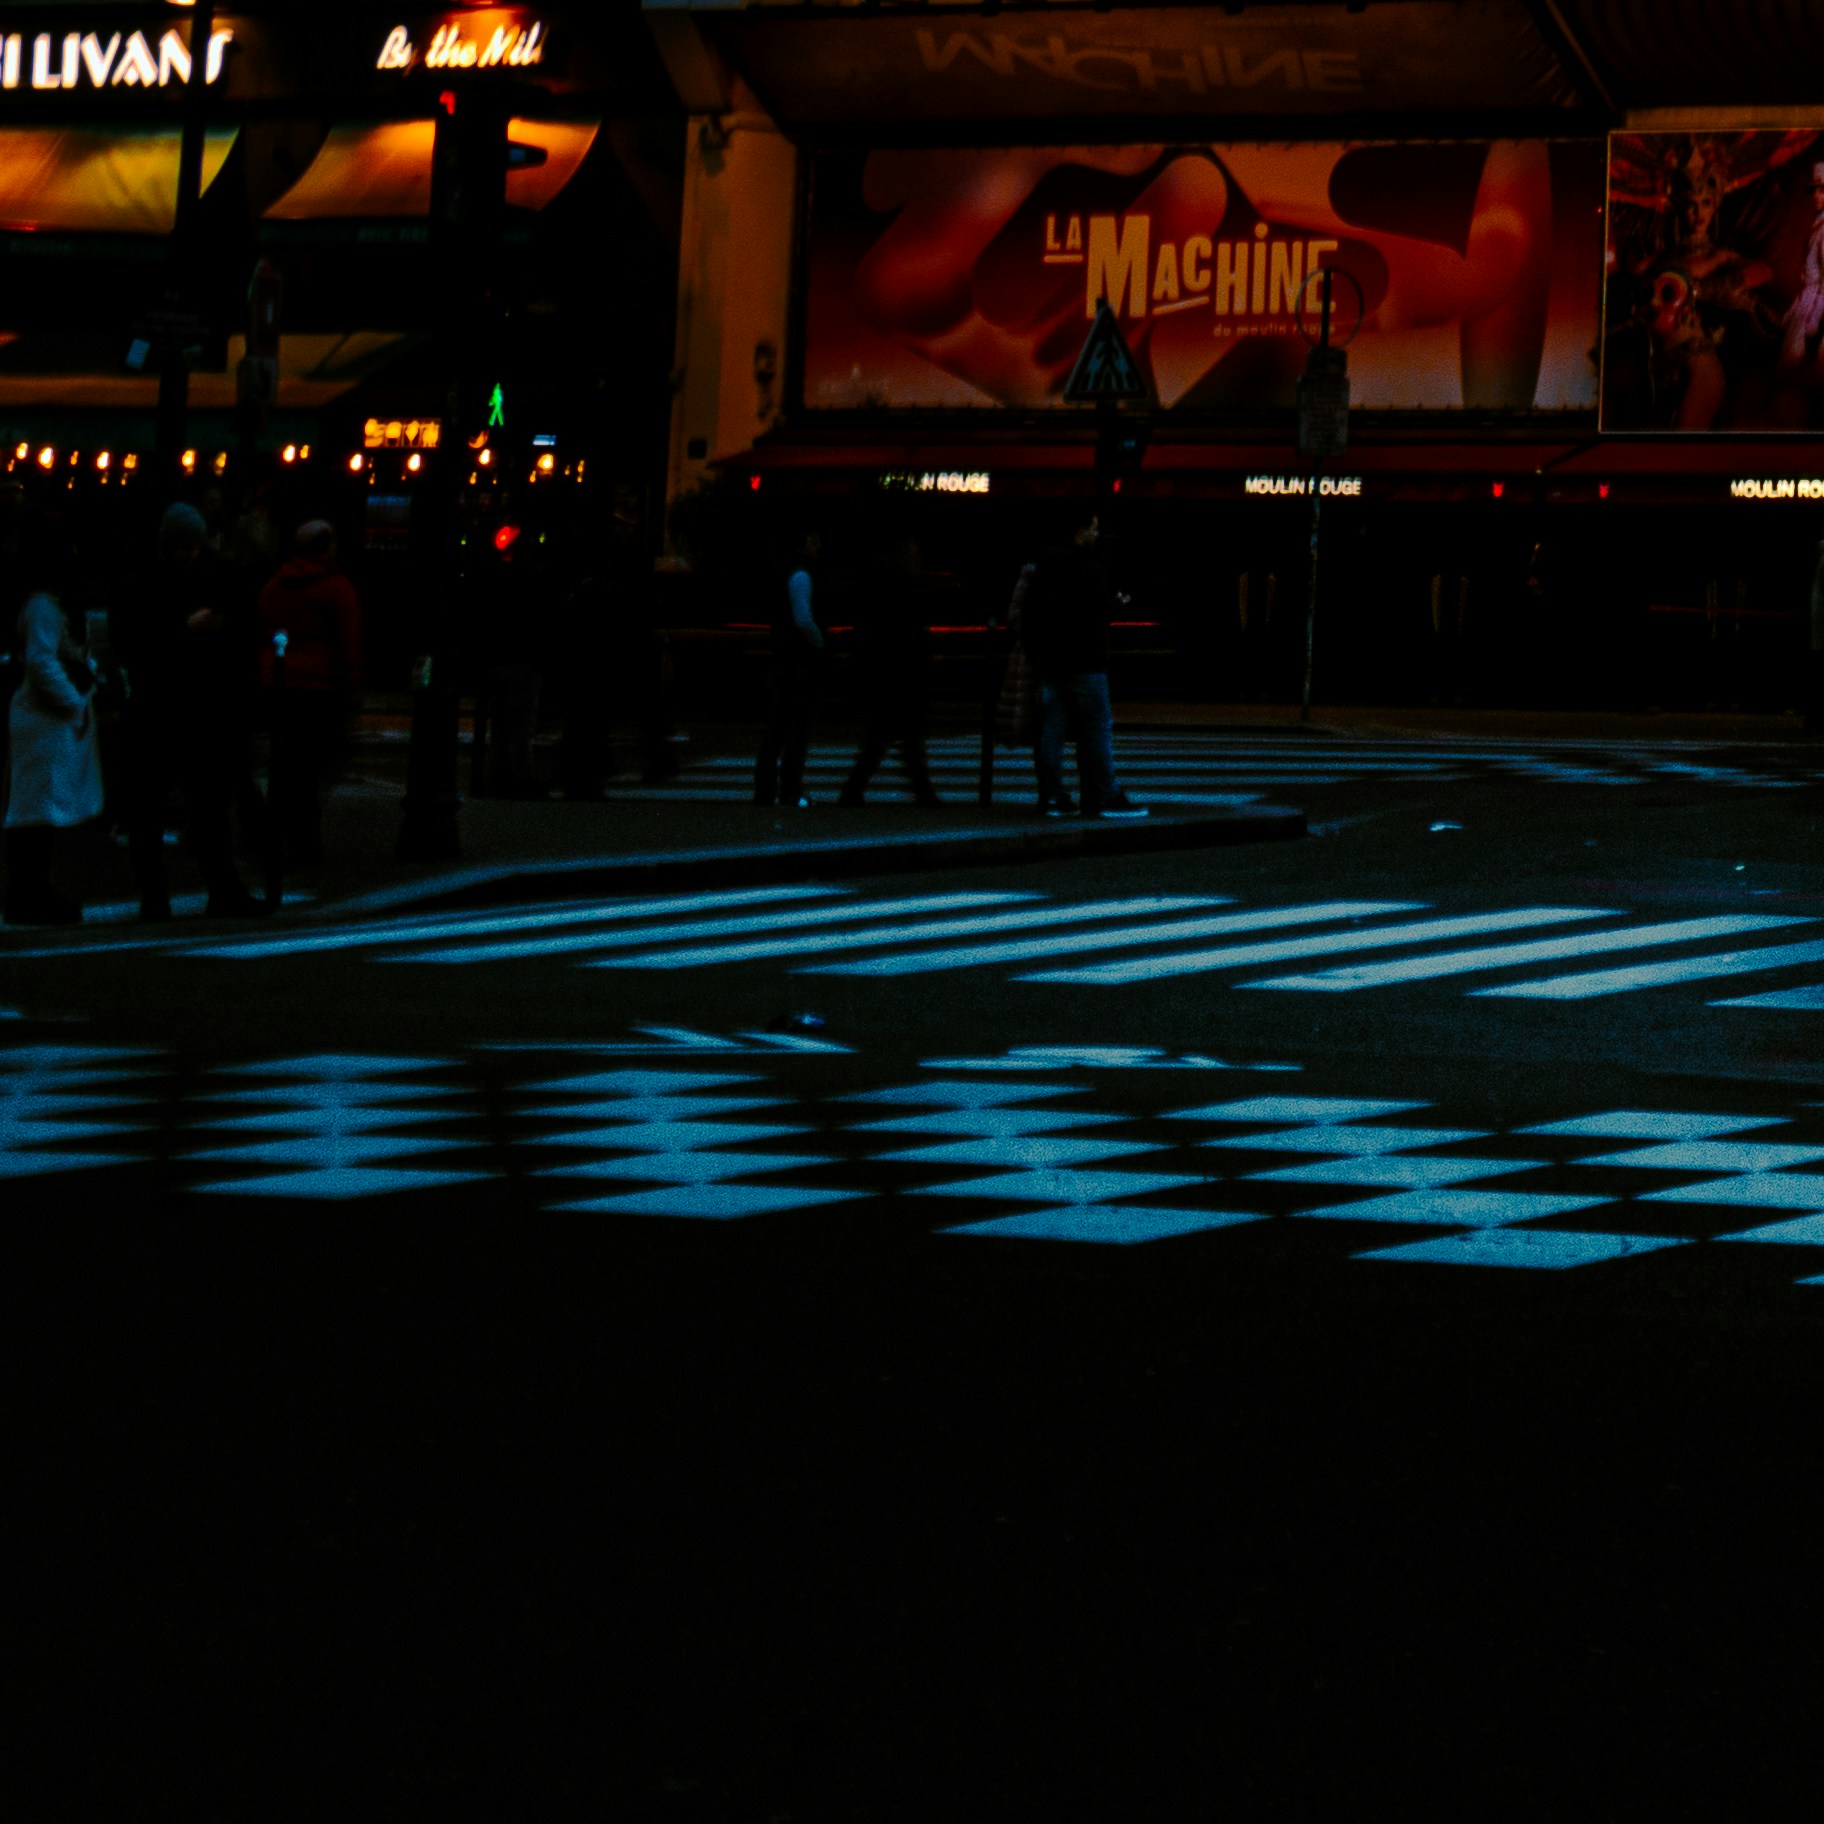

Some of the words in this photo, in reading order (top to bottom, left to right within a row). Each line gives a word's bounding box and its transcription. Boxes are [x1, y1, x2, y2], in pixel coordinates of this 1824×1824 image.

[1044, 215, 1083, 252] LA
[936, 471, 990, 493] ROUGE
[1245, 475, 1306, 495] MOULIN
[1730, 479, 1796, 499] MOULIN
